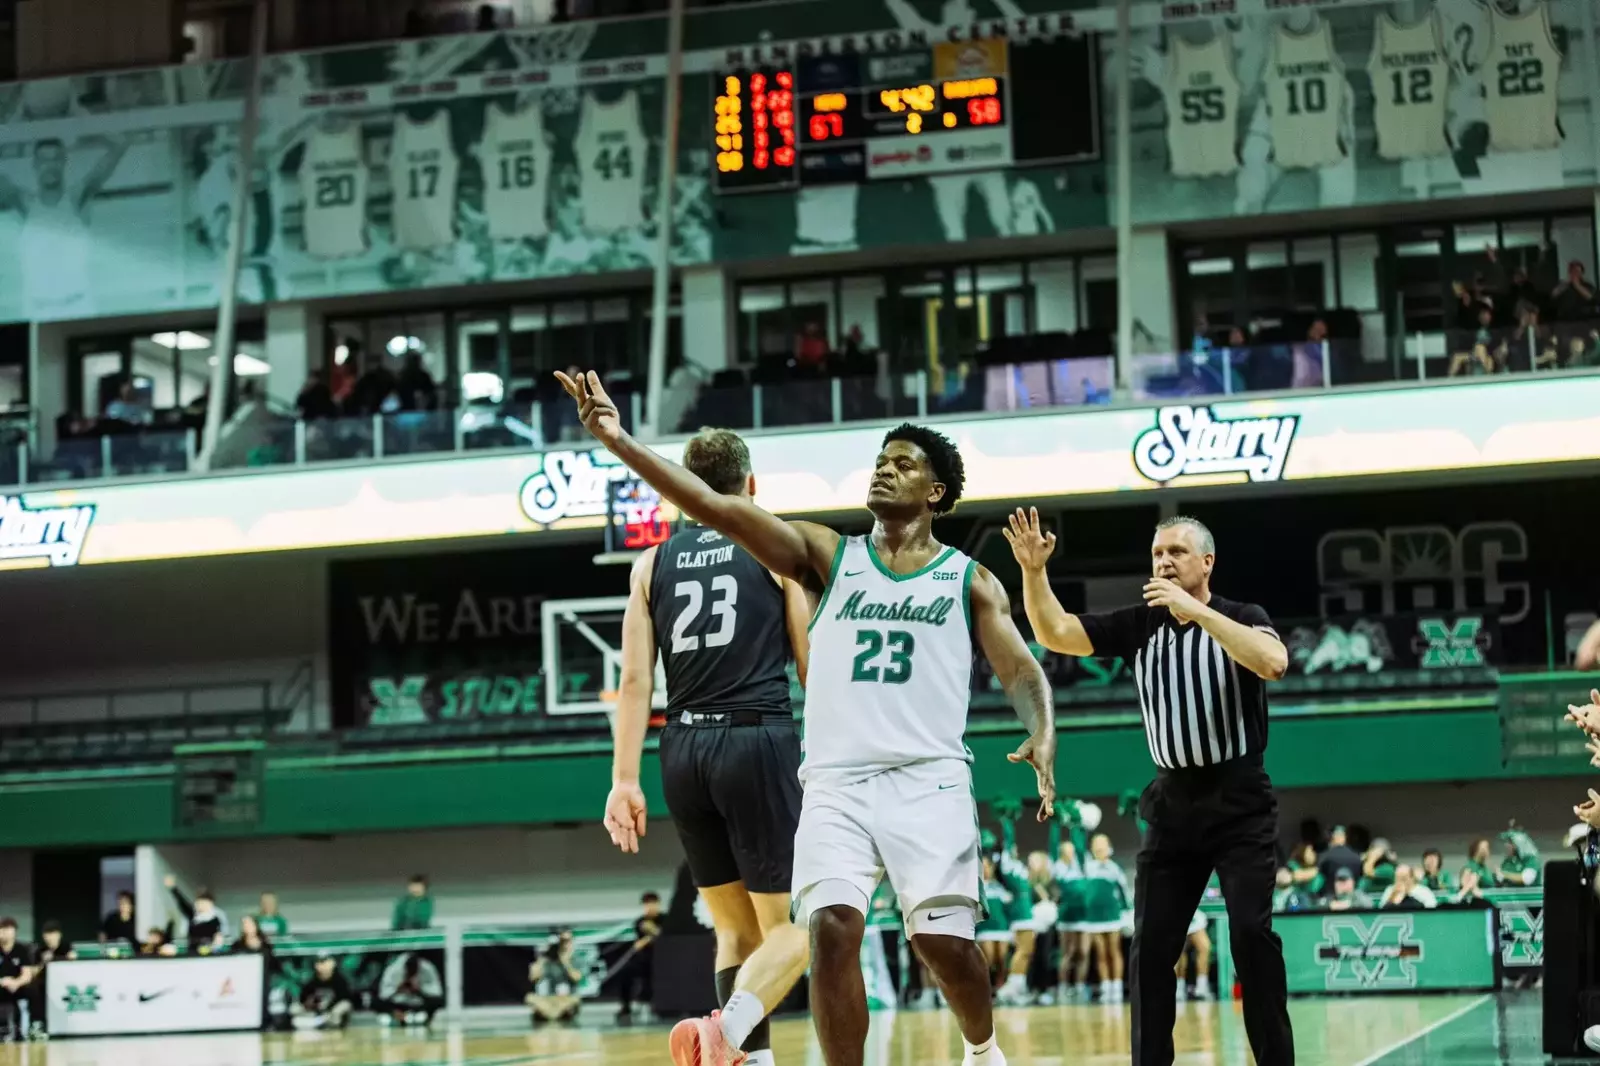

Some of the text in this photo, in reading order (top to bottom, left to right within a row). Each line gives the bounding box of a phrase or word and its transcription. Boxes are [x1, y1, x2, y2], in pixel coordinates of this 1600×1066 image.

[1286, 78, 1327, 115] 10
[1391, 68, 1433, 106] 12
[1497, 59, 1544, 97] 22
[1180, 87, 1226, 124] 55
[499, 155, 535, 190] 16
[593, 145, 633, 181] 44
[315, 174, 354, 209] 20
[408, 165, 440, 200] 17
[1134, 405, 1297, 483] Starry
[520, 450, 640, 524] Sta
[0, 494, 93, 567] tarry
[675, 544, 736, 569] CLAYTON
[932, 570, 959, 581] SBC
[358, 592, 440, 643] WE
[671, 574, 739, 654] 23
[835, 589, 956, 627] Marshall
[850, 628, 916, 684] 23
